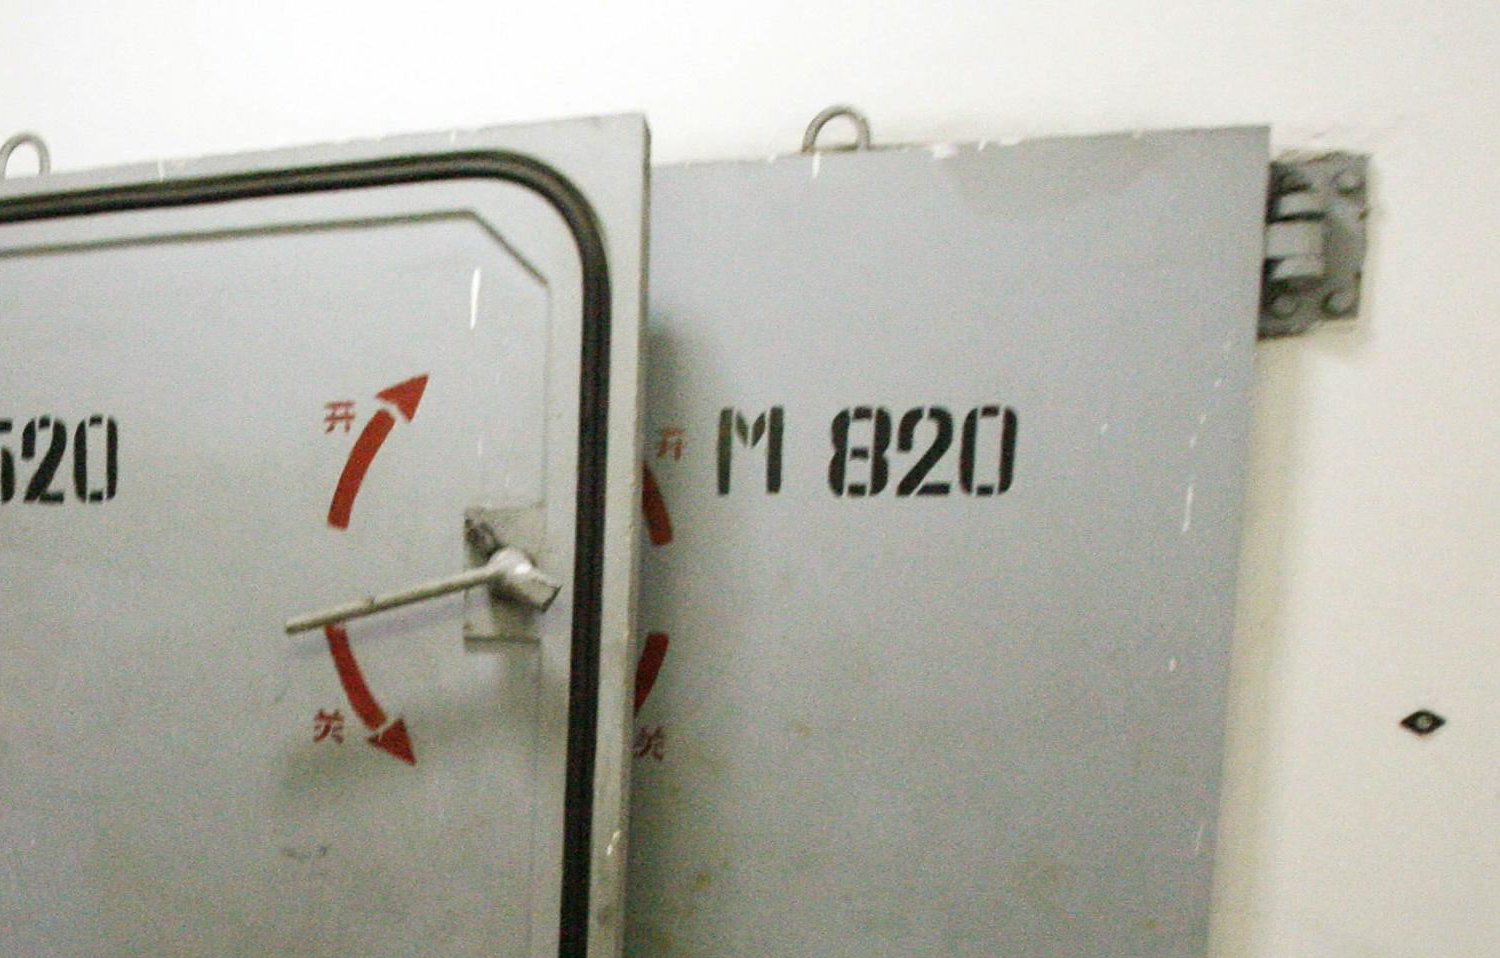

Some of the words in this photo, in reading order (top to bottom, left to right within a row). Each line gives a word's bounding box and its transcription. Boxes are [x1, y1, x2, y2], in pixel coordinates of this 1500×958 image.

[324, 401, 355, 432] 开
[718, 405, 784, 496] M
[828, 405, 1018, 497] 820
[313, 708, 345, 743] 关
